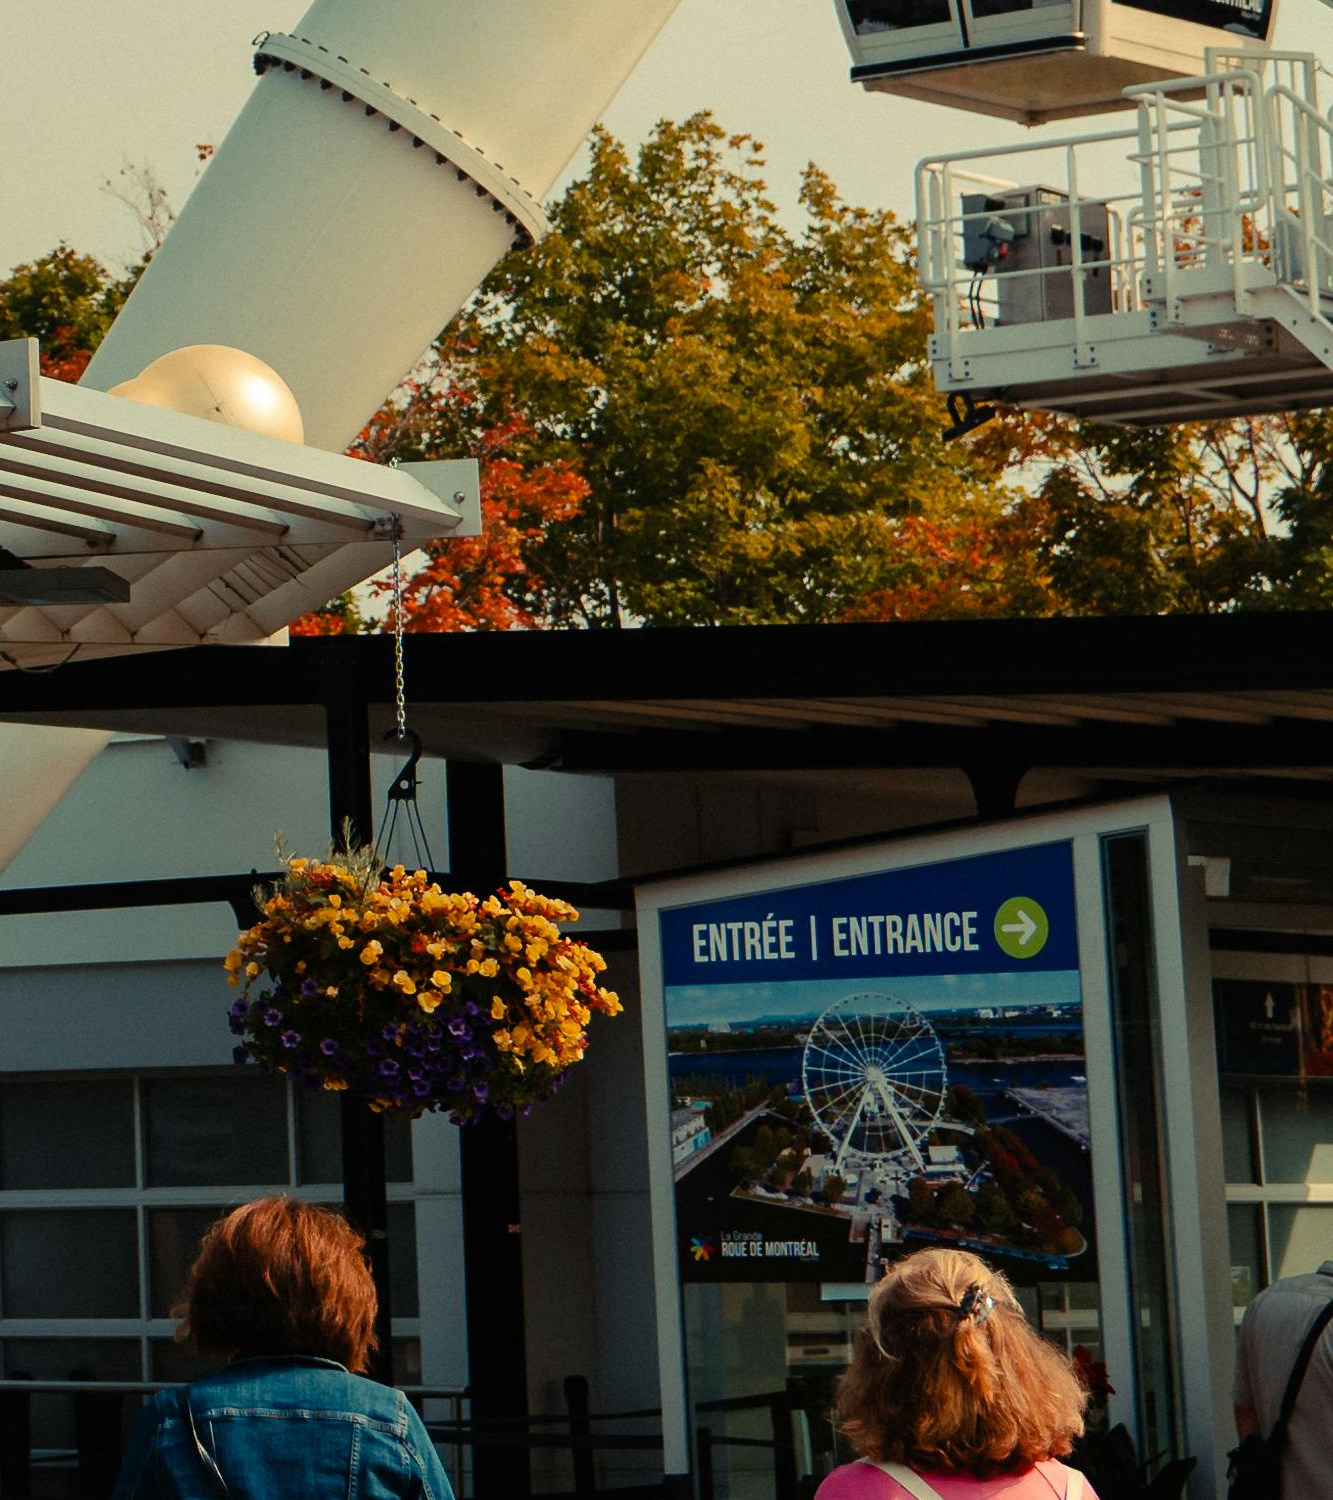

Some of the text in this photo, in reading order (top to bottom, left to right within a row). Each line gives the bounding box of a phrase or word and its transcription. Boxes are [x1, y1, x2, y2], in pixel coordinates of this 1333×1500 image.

[692, 912, 795, 963] ENTRÉE
[832, 911, 979, 957] ENTRANCE
[722, 1238, 820, 1257] ROUE DE MONTRÉAL
